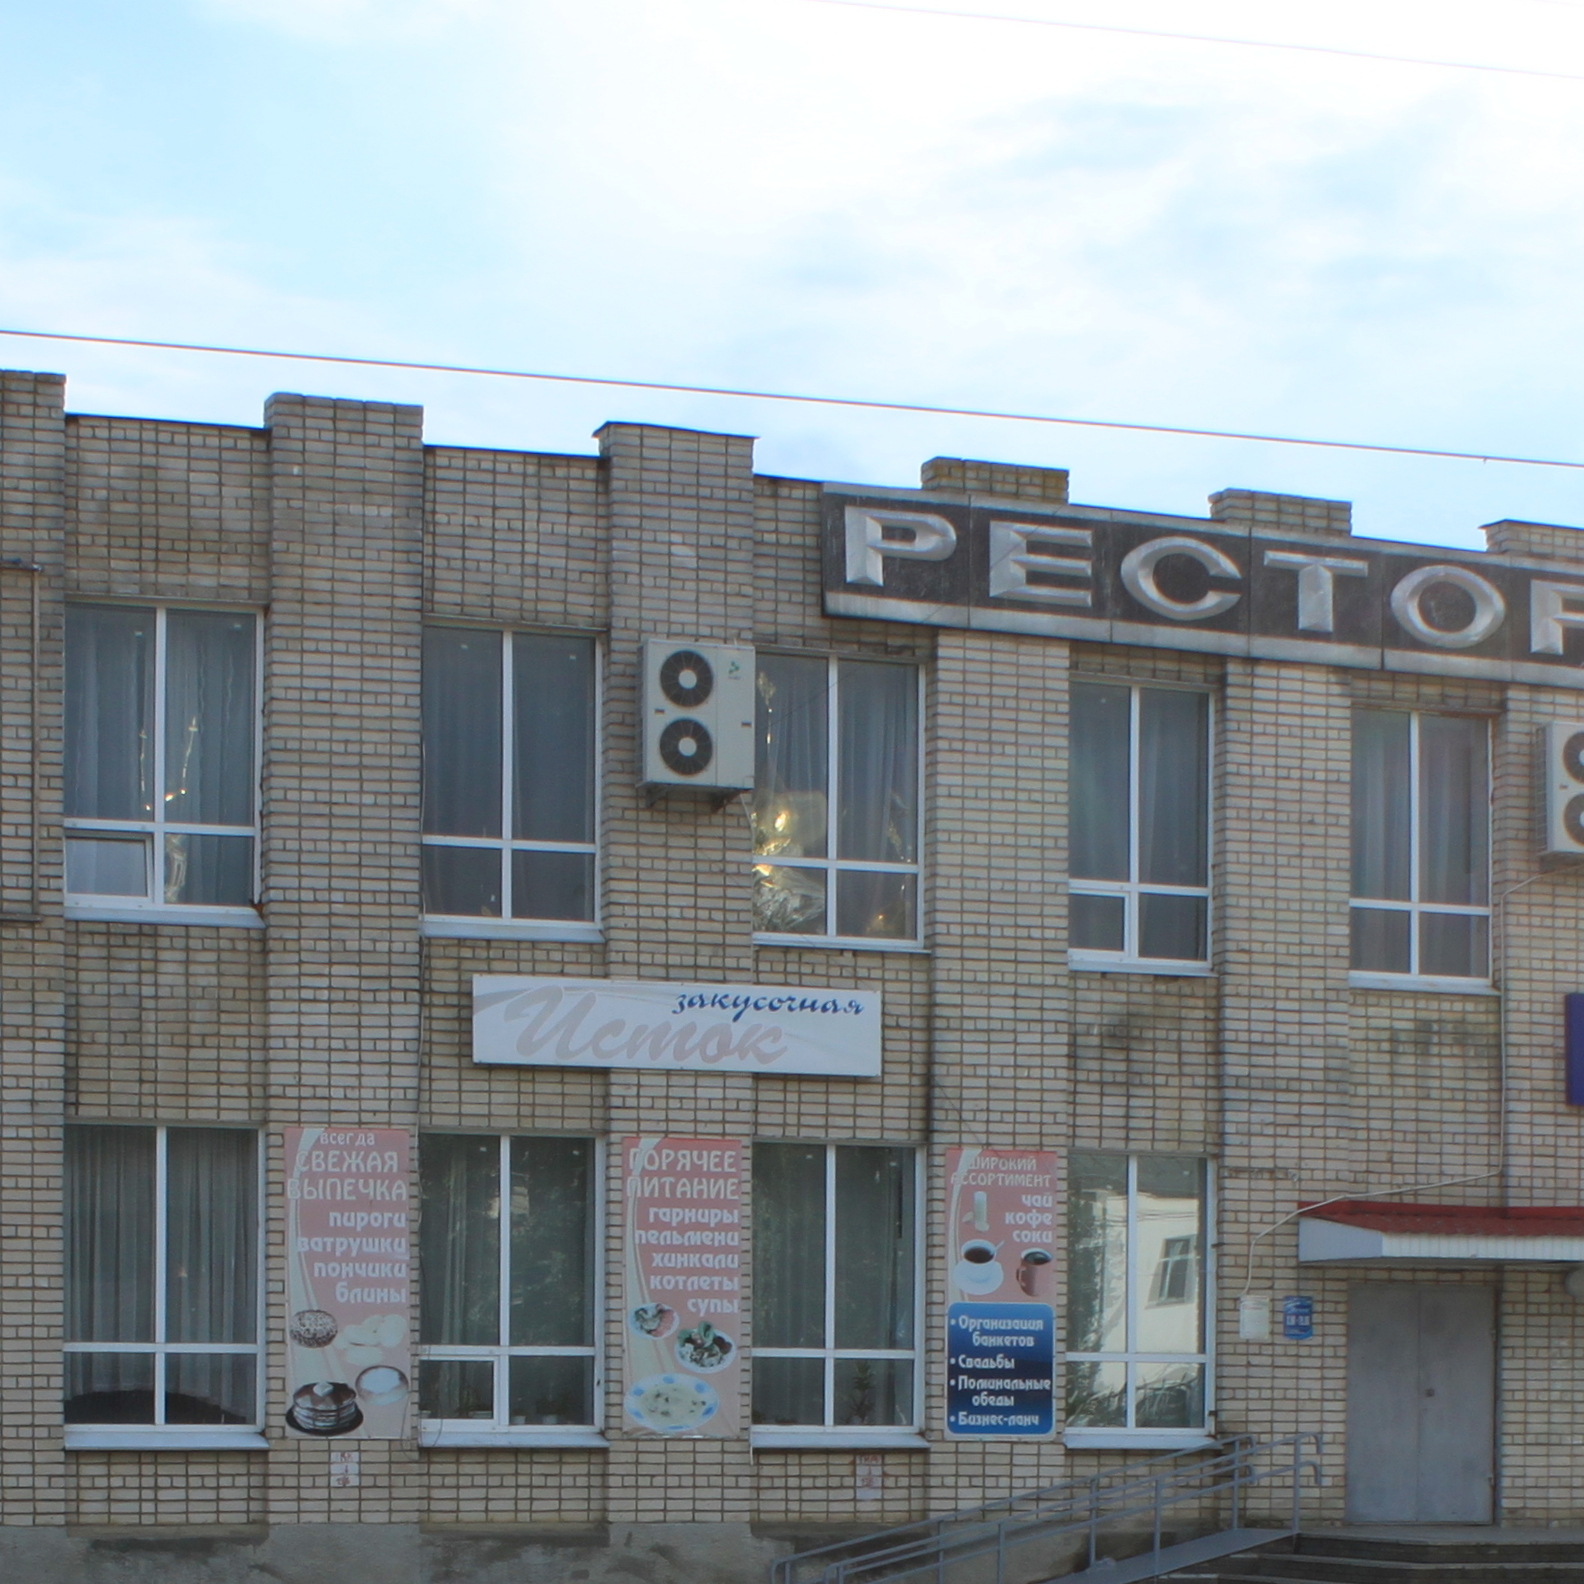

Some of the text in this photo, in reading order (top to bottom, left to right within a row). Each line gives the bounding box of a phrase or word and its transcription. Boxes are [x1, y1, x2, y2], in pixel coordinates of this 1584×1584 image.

[671, 992, 865, 1022] закусочная
[503, 985, 788, 1065] Исток
[319, 1132, 375, 1147] всегда
[296, 1151, 398, 1173] СВЕЖАЯ
[629, 1148, 737, 1173] ГОРЯЧЕЕ
[968, 1155, 1037, 1171] ШИРОКИЙ
[626, 1176, 739, 1200] ПИТАНИЕ
[950, 1172, 1051, 1188] АССОРТИМЕНТ
[287, 1178, 408, 1201] ВЫПЕЧКА
[1021, 1192, 1053, 1208] чай
[329, 1211, 407, 1231] пироги
[648, 1207, 739, 1226] гарниры
[1005, 1210, 1053, 1229] кофе
[635, 1230, 739, 1247] пельмени
[1012, 1230, 1053, 1244] соки
[297, 1236, 407, 1256] ватрушки
[651, 1253, 739, 1269] хинкали
[314, 1261, 407, 1279] пончики
[650, 1274, 739, 1291] котлеты
[335, 1282, 407, 1303] блины
[687, 1297, 739, 1317] супы
[958, 1315, 1044, 1332] Организация
[972, 1331, 1035, 1347] банкетов
[958, 1353, 1015, 1369] Свадьбы
[958, 1375, 1051, 1391] Поминальные
[972, 1391, 1014, 1407] обеды
[958, 1411, 1040, 1426] Бизнес-ланч
